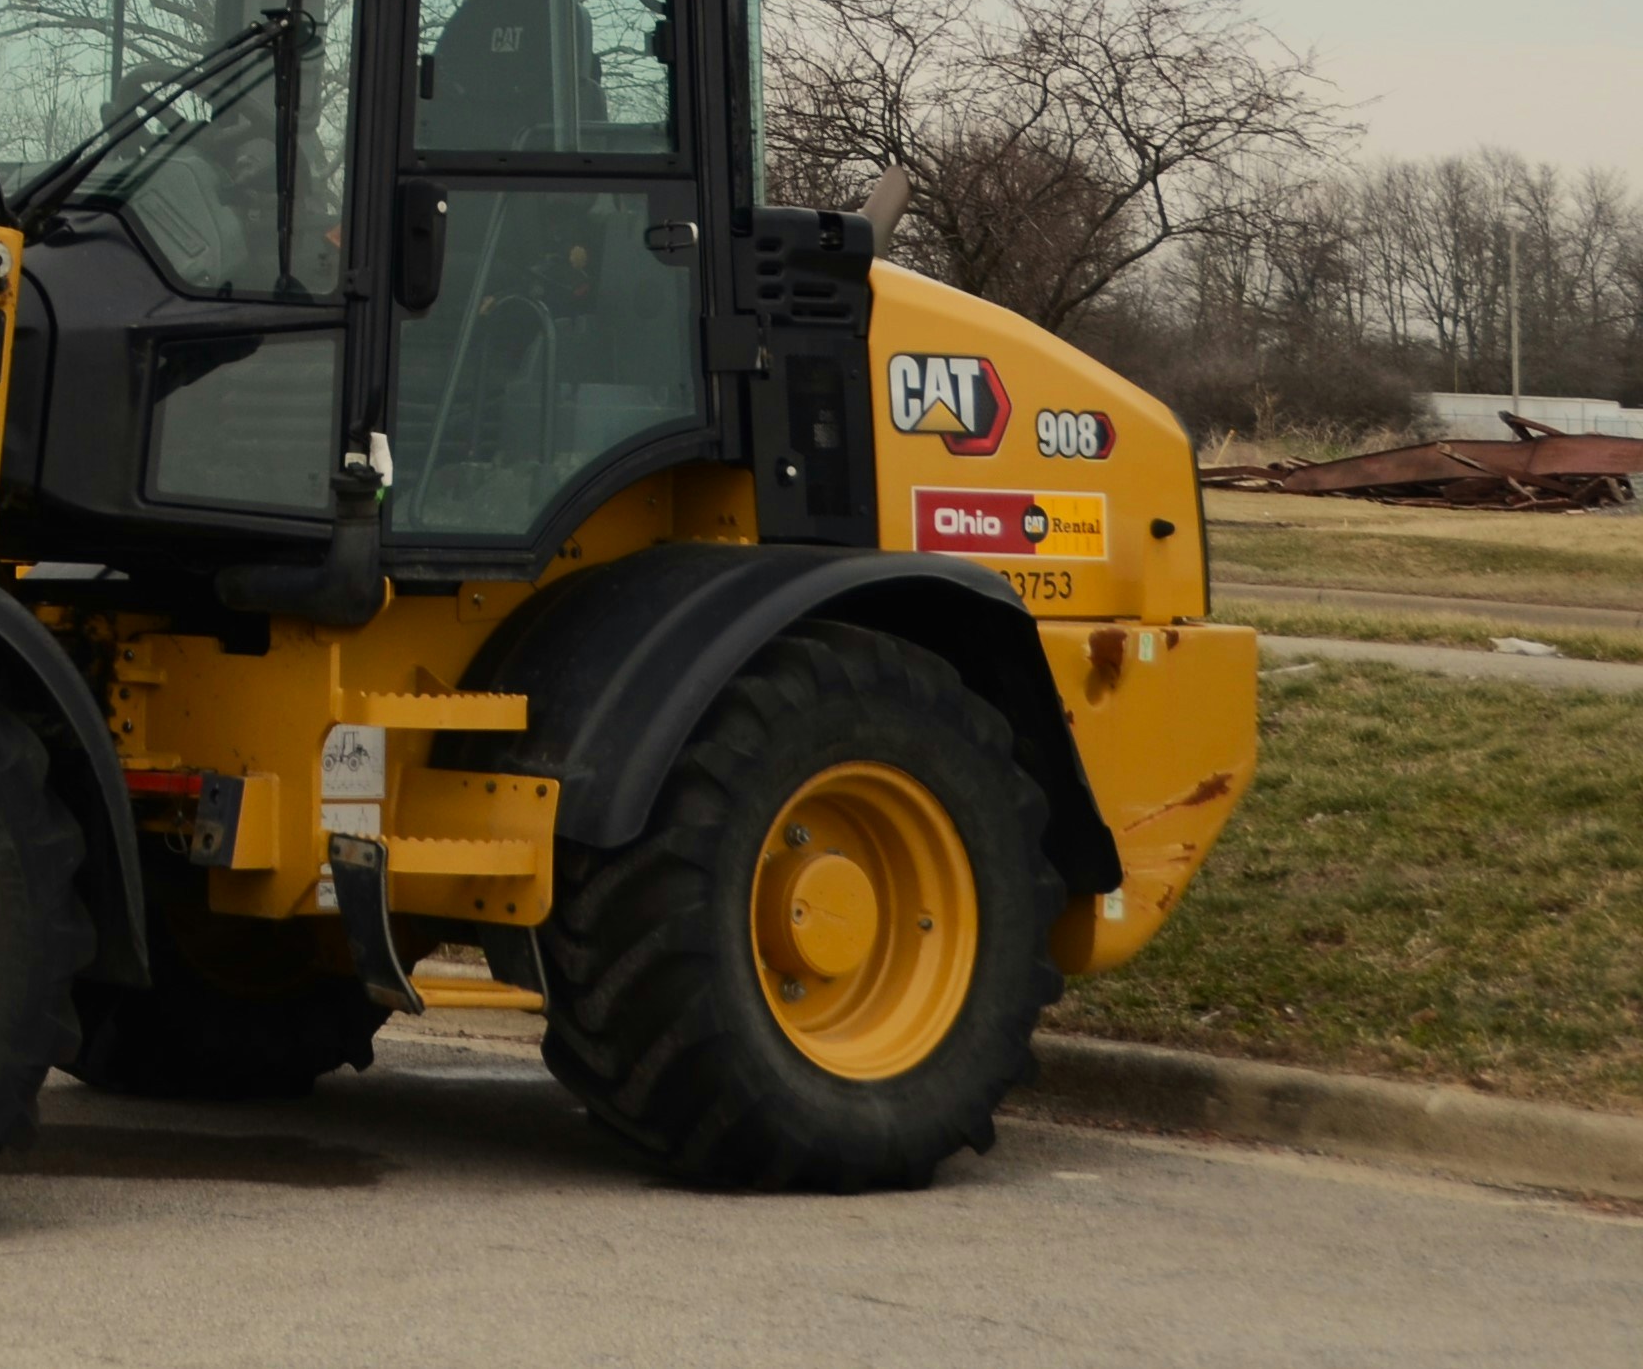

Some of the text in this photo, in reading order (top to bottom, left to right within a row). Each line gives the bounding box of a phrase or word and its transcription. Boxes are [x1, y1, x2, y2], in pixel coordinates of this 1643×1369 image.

[491, 27, 523, 51] CAT
[889, 354, 980, 432] CAT
[1037, 410, 1098, 457] 908
[934, 508, 1101, 535] Ohio CAT Rental
